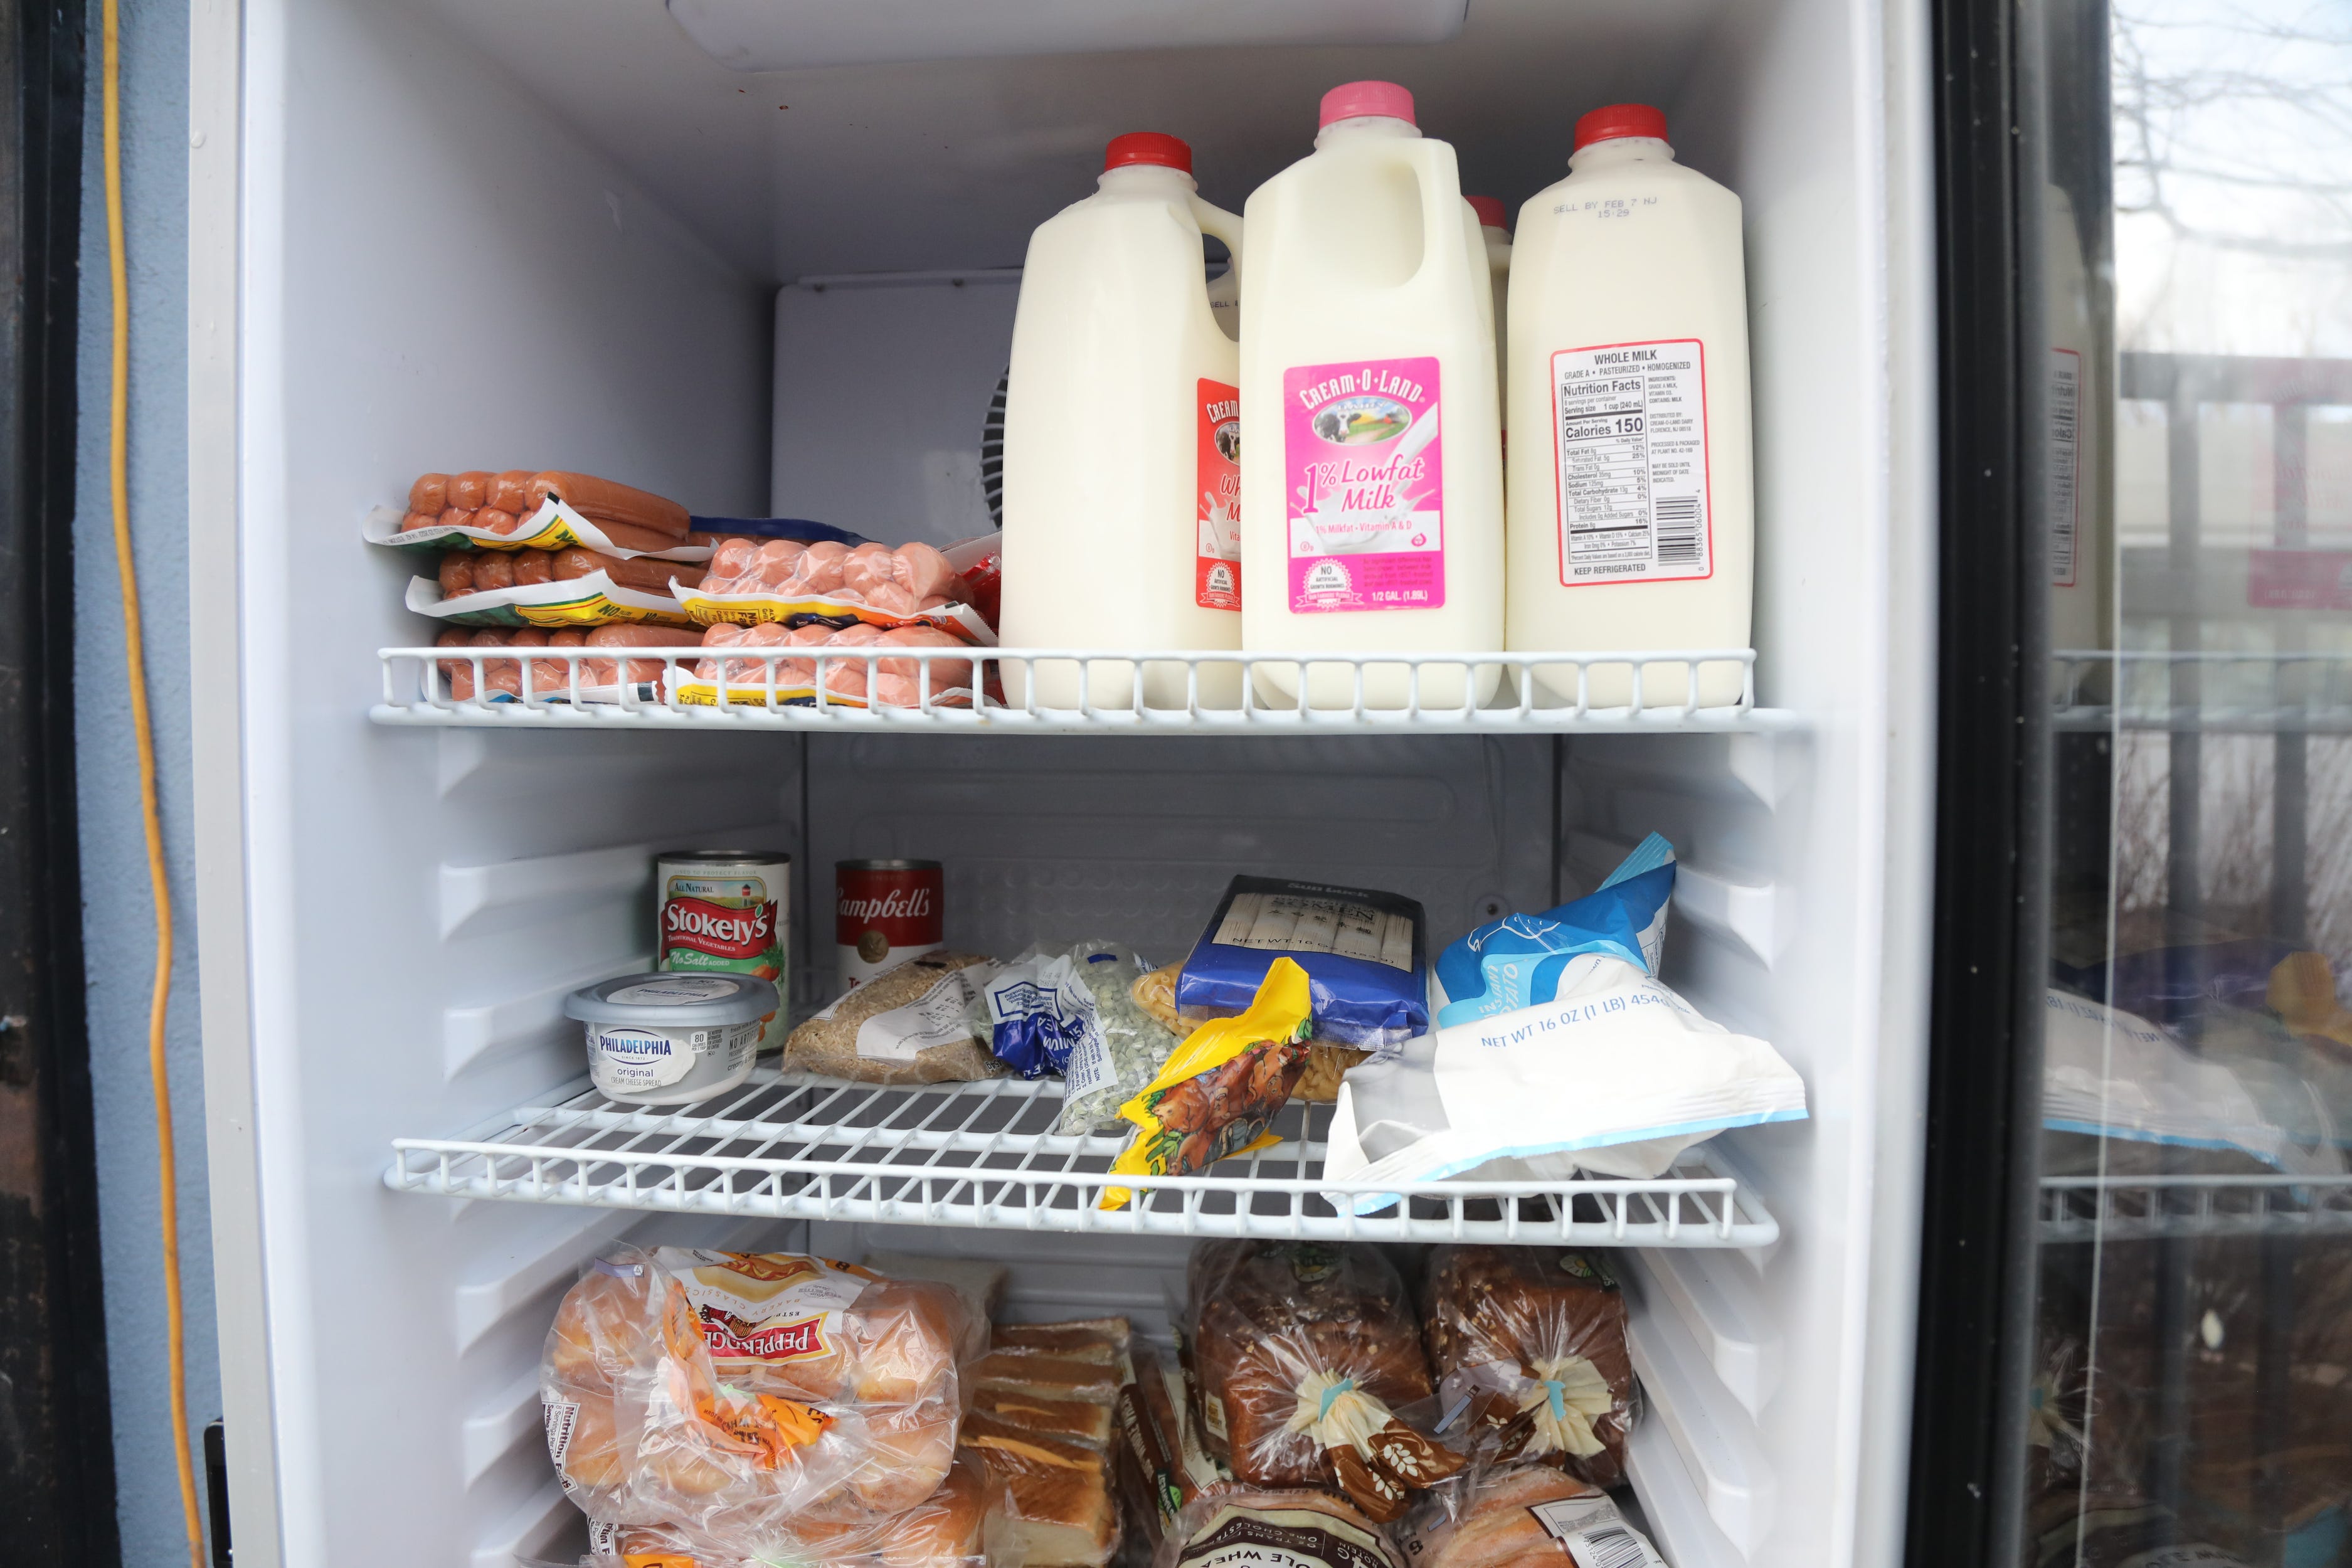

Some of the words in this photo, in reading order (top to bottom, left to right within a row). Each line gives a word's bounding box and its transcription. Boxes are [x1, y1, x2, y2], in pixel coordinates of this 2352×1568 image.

[1554, 205, 1578, 214] SELL
[1585, 201, 1597, 209] BY
[1595, 352, 1629, 364] WHOLE
[1633, 349, 1657, 361] MILK
[1565, 371, 1582, 379] GRADE
[1599, 365, 1640, 375] PASTEURIZED
[1648, 362, 1690, 371] HOMOGENIZED
[1564, 383, 1609, 396] Nutrition
[1612, 379, 1641, 391] Facts
[1565, 406, 1584, 415] Serving
[1609, 403, 1619, 411] cup
[1620, 401, 1632, 409] (240
[1566, 425, 1611, 438] Calories
[1616, 418, 1643, 433] 150
[1342, 454, 1424, 483] Lowfat
[1583, 487, 1618, 495] Carbohydrate
[1341, 486, 1396, 512] Milk
[1328, 524, 1353, 533] Milkfat
[1360, 522, 1390, 532] Vitamin
[1392, 522, 1397, 530] A
[1406, 521, 1412, 529] D
[1217, 568, 1225, 579] NO
[1320, 566, 1332, 575] NO
[1574, 566, 1592, 575] KEEP
[1594, 563, 1646, 574] REFRIGERATED
[1372, 591, 1384, 601] 1/2
[1385, 591, 1402, 600] GAL.
[598, 605, 620, 617] NO
[667, 904, 768, 946] Stokely's
[671, 951, 683, 964] No
[684, 953, 709, 965] Salt
[1481, 1036, 1508, 1047] NET
[1511, 1024, 1534, 1044] WT
[1539, 1019, 1557, 1032] 16
[1560, 1008, 1581, 1025] OZ
[1584, 1004, 1598, 1021] (1
[1602, 996, 1627, 1014] LB)
[600, 1035, 672, 1056] PHILADELPHIA
[695, 1034, 704, 1042] 80
[729, 1038, 738, 1050] NO
[617, 1068, 653, 1078] original
[684, 1286, 745, 1310] CLASSICS
[751, 1298, 800, 1315] BAKERY
[551, 1411, 561, 1436] Servings
[556, 1406, 575, 1458] Nutrition
[1247, 1530, 1292, 1544] TRANS
[1200, 1550, 1261, 1568] WHEA
[1338, 1541, 1378, 1568] ROTEIN
